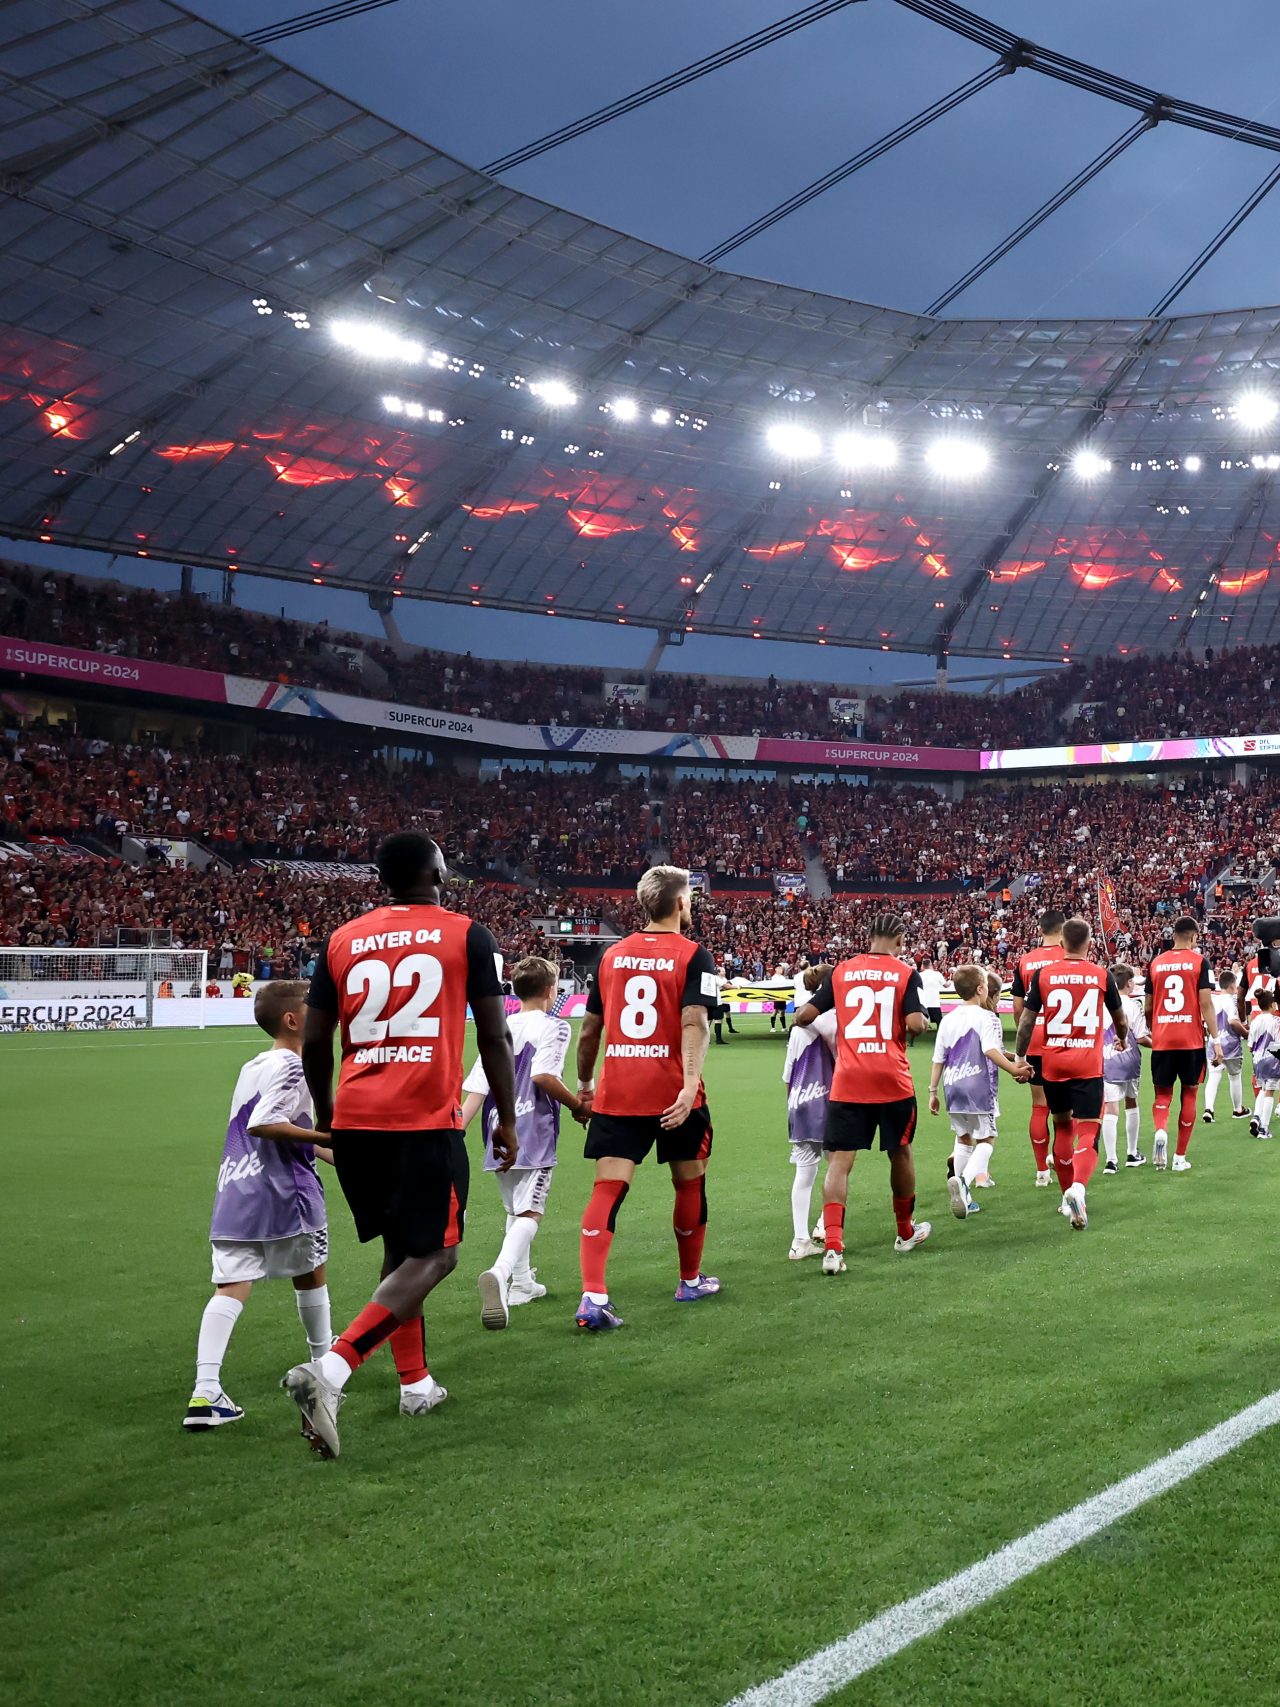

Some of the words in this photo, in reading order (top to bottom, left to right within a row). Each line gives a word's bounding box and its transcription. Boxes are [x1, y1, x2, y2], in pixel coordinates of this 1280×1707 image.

[15, 649, 100, 673] SUPERCUP
[103, 664, 140, 681] 2024
[389, 711, 446, 728] SUPERCUP
[448, 720, 473, 733] 2024
[831, 749, 890, 761] SUPERCUP
[892, 752, 919, 762] 2024
[351, 931, 412, 955] BAYER
[415, 929, 441, 944] 04
[613, 956, 655, 971] BAYER
[655, 957, 675, 972] 04
[844, 970, 882, 982] BAYER
[883, 971, 899, 982] 04
[1155, 963, 1182, 972] BAYER
[1182, 963, 1193, 972] 04
[1049, 974, 1083, 985] BAYER
[1085, 975, 1099, 985] 04
[346, 953, 443, 1044] 22
[1163, 974, 1185, 1012] 3
[83, 1005, 136, 1021] 2024
[619, 975, 658, 1039] 8
[844, 985, 896, 1040] 21
[1046, 988, 1100, 1035] 24
[605, 1044, 669, 1058] ANDRICH
[857, 1042, 887, 1054] ADLI
[943, 1061, 982, 1087] Milka
[787, 1080, 829, 1111] Milka
[217, 1150, 265, 1193] Milk
